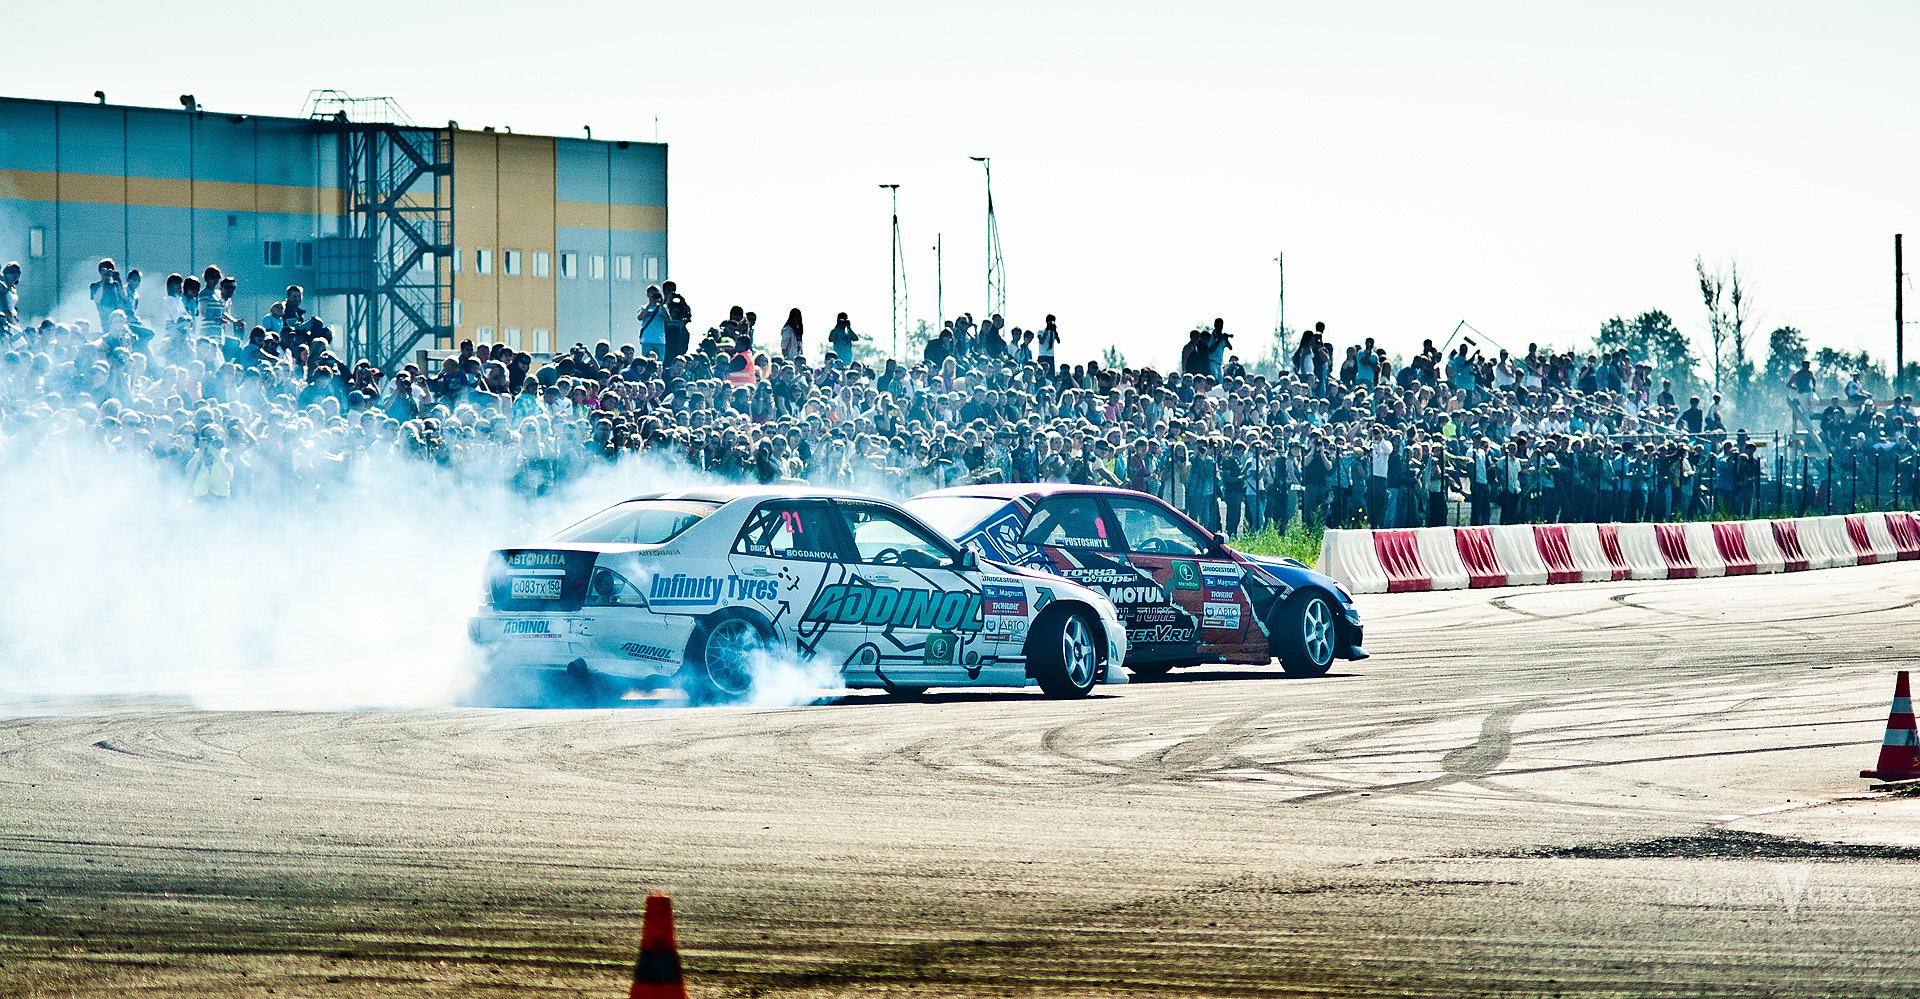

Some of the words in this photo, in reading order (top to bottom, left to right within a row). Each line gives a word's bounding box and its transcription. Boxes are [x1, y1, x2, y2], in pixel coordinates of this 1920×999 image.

[782, 511, 804, 534] 21
[1065, 537, 1102, 548] PUSTOSHNY
[508, 553, 566, 566] АВТОПАПА
[547, 580, 560, 591] 150
[982, 575, 1021, 584] BRIDGESTONE
[649, 574, 724, 606] Infinity
[728, 575, 778, 601] Tyres
[999, 589, 1024, 598] Magnum
[1110, 586, 1165, 604] MOTUL
[803, 585, 985, 631] ADDINOL
[992, 602, 1020, 610] ТЮНИНГ
[503, 620, 551, 634] ADDINOL
[620, 642, 673, 659] ADDINOL
